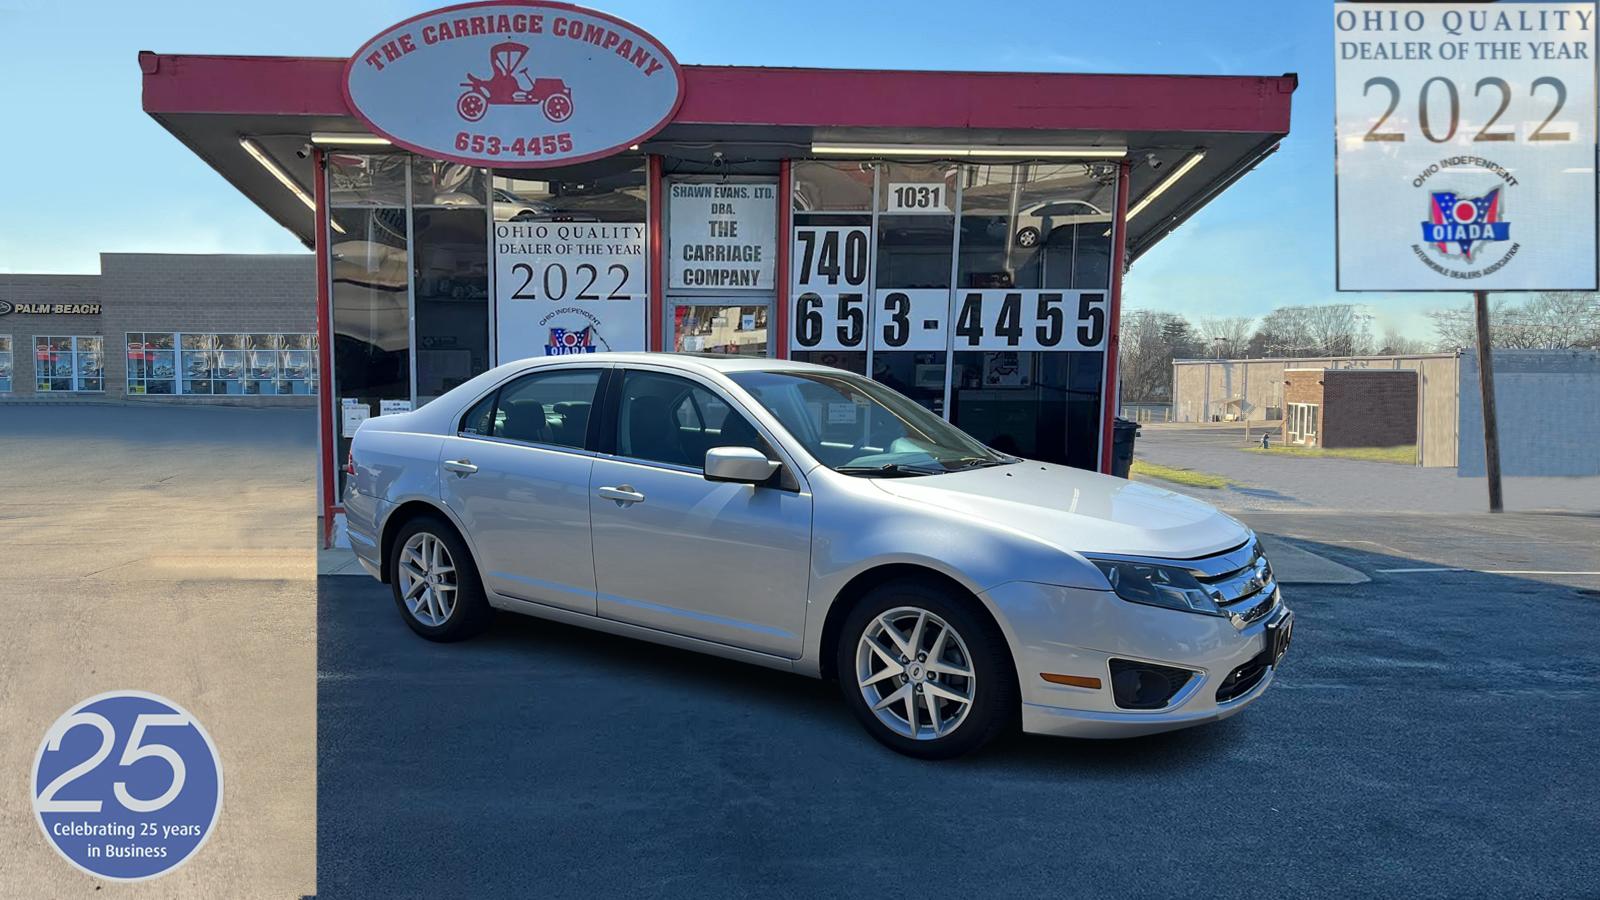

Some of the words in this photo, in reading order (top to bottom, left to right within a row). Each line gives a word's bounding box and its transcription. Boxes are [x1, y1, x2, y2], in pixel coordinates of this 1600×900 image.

[1336, 10, 1425, 31] OHIO
[1442, 10, 1593, 36] QUALITY
[366, 33, 417, 72] THE
[422, 14, 544, 46] CARRIAGE
[553, 17, 664, 77] COMPANY
[1340, 42, 1433, 60] DEALER
[1438, 42, 1470, 60] OF
[1475, 42, 1522, 60] THE
[1528, 41, 1589, 60] YEAR
[1363, 76, 1571, 143] 2022
[454, 131, 573, 157] 653-4455
[1412, 164, 1439, 188] OHIO
[1440, 155, 1519, 188] INDEPENDENT
[673, 186, 712, 198] SHAWN
[714, 187, 750, 198] EVANS.
[754, 187, 775, 199] LTD.
[894, 186, 941, 208] 1031
[711, 203, 736, 215] DBA.
[497, 226, 548, 239] OHIO
[558, 225, 645, 240] QUALITY
[708, 220, 738, 238] THE
[1433, 224, 1495, 240] OIADA
[499, 243, 552, 255] DEALER
[556, 243, 574, 255] OF
[576, 243, 603, 255] THE
[606, 243, 642, 255] YEAR
[683, 245, 762, 262] CARRIAGE
[797, 230, 868, 286] 740
[1411, 244, 1449, 277] AUTOMOBILE
[1450, 269, 1482, 280] DEALERS
[1482, 242, 1521, 277] ASSOCIATION
[511, 263, 632, 301] 2022
[683, 269, 761, 286] COMPANY
[15, 304, 51, 314] PALM
[55, 304, 101, 314] BEACH
[539, 312, 556, 326] OHIO
[555, 307, 601, 326] INDEPENDENT
